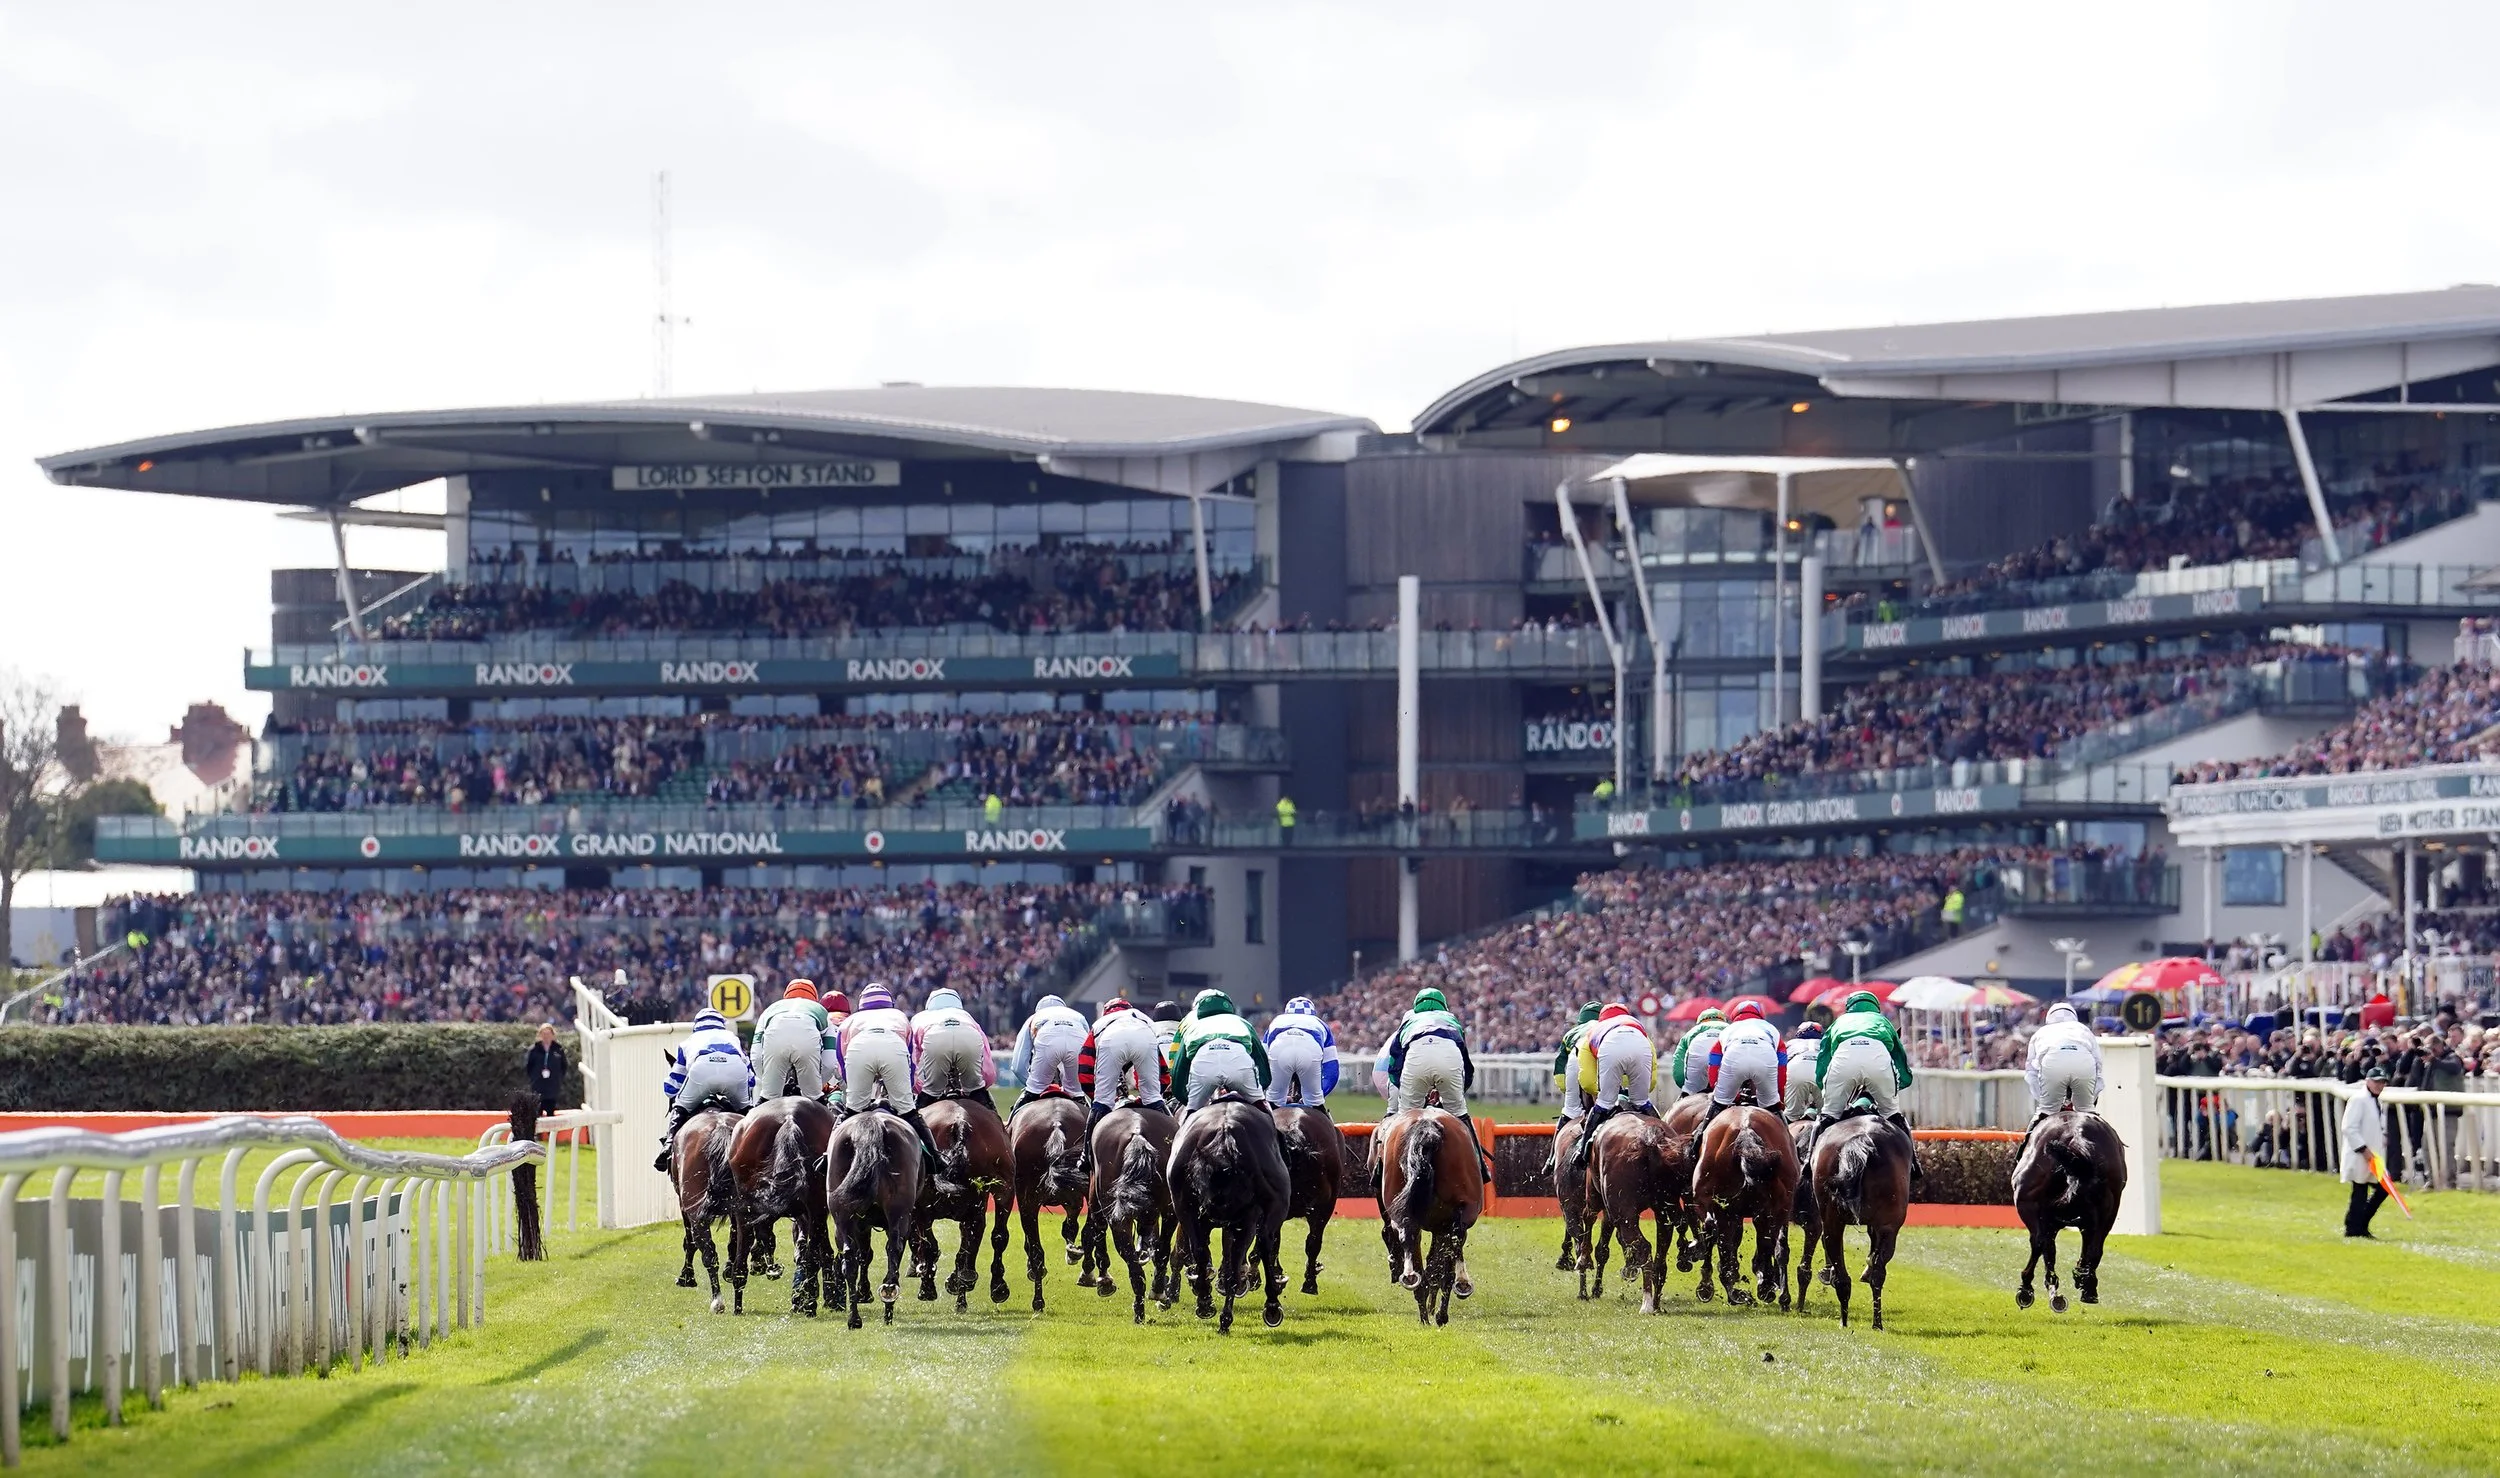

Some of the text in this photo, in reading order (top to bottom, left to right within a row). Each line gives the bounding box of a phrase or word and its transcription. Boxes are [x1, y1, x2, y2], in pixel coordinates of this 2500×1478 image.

[637, 464, 876, 487] LORD SEFTON STAND
[290, 663, 388, 687] RANDOX
[476, 663, 573, 686] RANDOX
[661, 662, 759, 683] RANDOX
[847, 660, 945, 681] RANDOX
[1034, 657, 1133, 678] RANDOX
[1721, 798, 1858, 828] RANDOX GRAND NATIONAL
[180, 836, 280, 859] RANDOX
[460, 832, 783, 856] RANDOX GRAND NATIONAL
[965, 829, 1067, 851] RANDOX
[721, 986, 741, 1011] H
